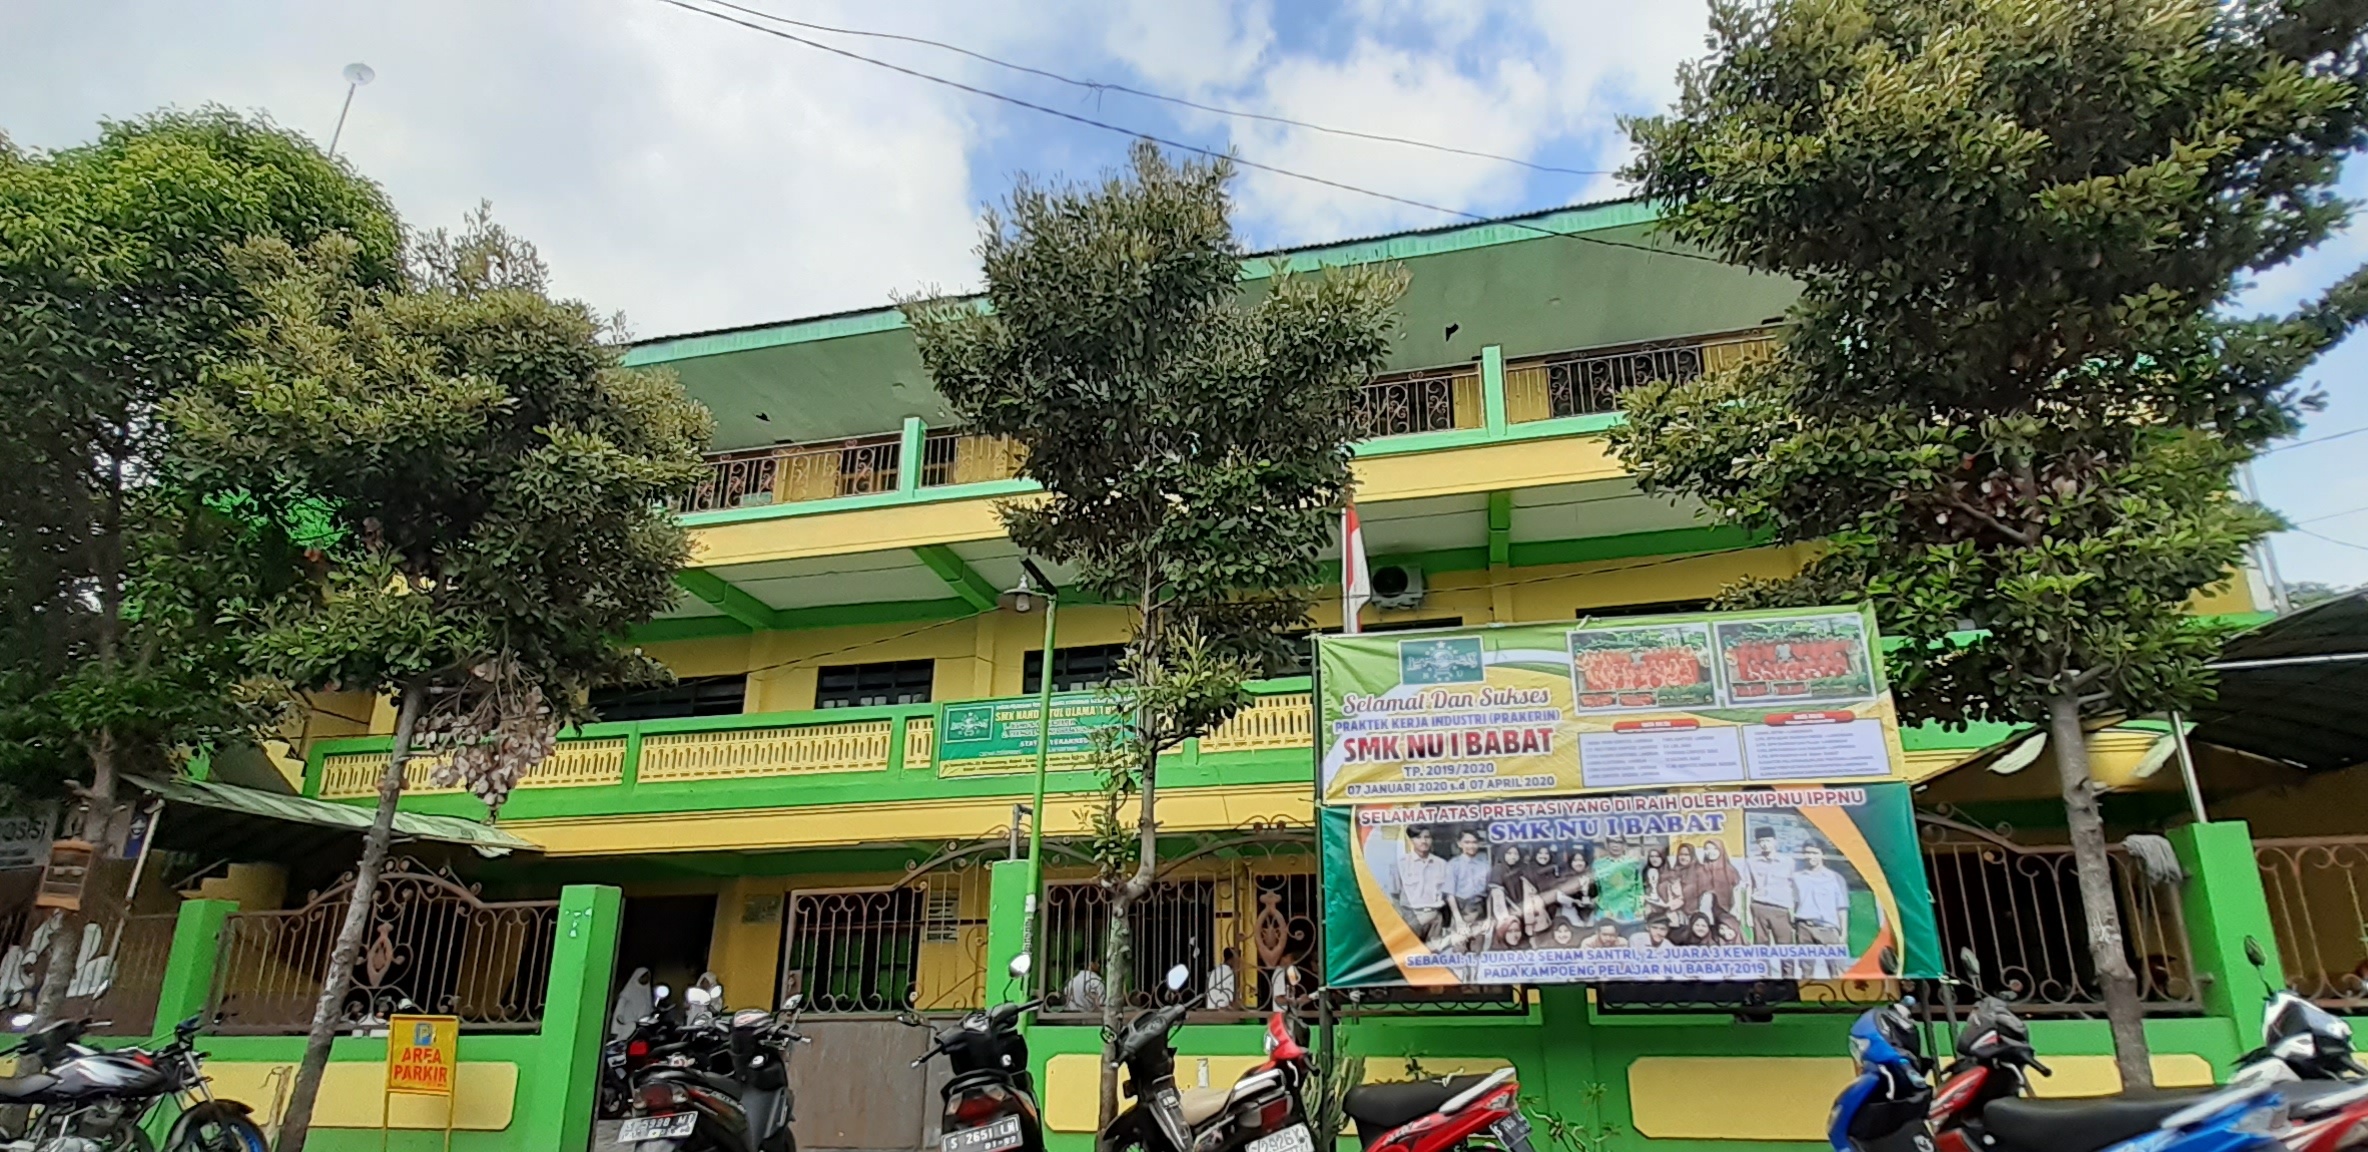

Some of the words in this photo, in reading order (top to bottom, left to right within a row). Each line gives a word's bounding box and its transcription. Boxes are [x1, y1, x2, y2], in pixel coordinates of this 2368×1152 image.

[1344, 692, 1425, 714] Selamat
[1430, 689, 1473, 709] Dan
[1480, 687, 1550, 707] Sukses
[1017, 707, 1064, 720] NAHDTUL
[1335, 718, 1388, 732] PRAKTEK
[1392, 716, 1428, 730] KERJA
[1432, 713, 1487, 728] INDUSTRI
[1489, 709, 1560, 726] (PRAKERIN)
[1343, 735, 1400, 763] SMK
[1407, 733, 1445, 759] NU
[1465, 727, 1554, 756] BABAT
[1404, 766, 1424, 778] TP.
[1426, 762, 1494, 776] 2019/2020
[1347, 785, 1362, 795] 07
[1364, 782, 1416, 795] JANUARI
[1418, 781, 1448, 792] 2020
[1470, 779, 1484, 789] 07
[1487, 777, 1522, 789] APRIL
[1525, 776, 1555, 787] 2020
[1360, 808, 1436, 825] SELAMAT
[1438, 805, 1479, 822] ATAS
[1482, 801, 1562, 819] PRESTASI
[1564, 798, 1611, 816] YANG
[1615, 796, 1632, 811] DI
[1636, 794, 1677, 811] RAIH
[1681, 792, 1731, 809] OLEH
[1760, 790, 1801, 807] IPNU
[1807, 788, 1865, 805] IPPNU
[1489, 821, 1553, 843] SMK
[1556, 818, 1602, 840] NU
[1625, 813, 1726, 835] BABAT
[1406, 954, 1465, 966] SEBAGAI:
[1481, 950, 1525, 964] JUARA
[1527, 950, 1536, 962] 2
[1539, 949, 1584, 962] SENAM
[1587, 948, 1641, 962] SANTRI,
[1646, 948, 1658, 960] 2.
[1663, 947, 1709, 960] JUARA
[1713, 947, 1721, 958] 3
[1723, 945, 1847, 959] KEWIRAUSAHAAN
[1484, 965, 1520, 979] PADA
[1522, 963, 1595, 978] KAMPOENG
[1599, 962, 1660, 977] PELAJAR
[1664, 962, 1683, 975] NU
[1686, 962, 1731, 974] BABAT
[1734, 961, 1766, 974] 2019
[401, 1047, 442, 1063] AREA
[394, 1065, 447, 1082] PARKIR
[950, 1137, 959, 1150] S
[966, 1127, 993, 1145] 2651
